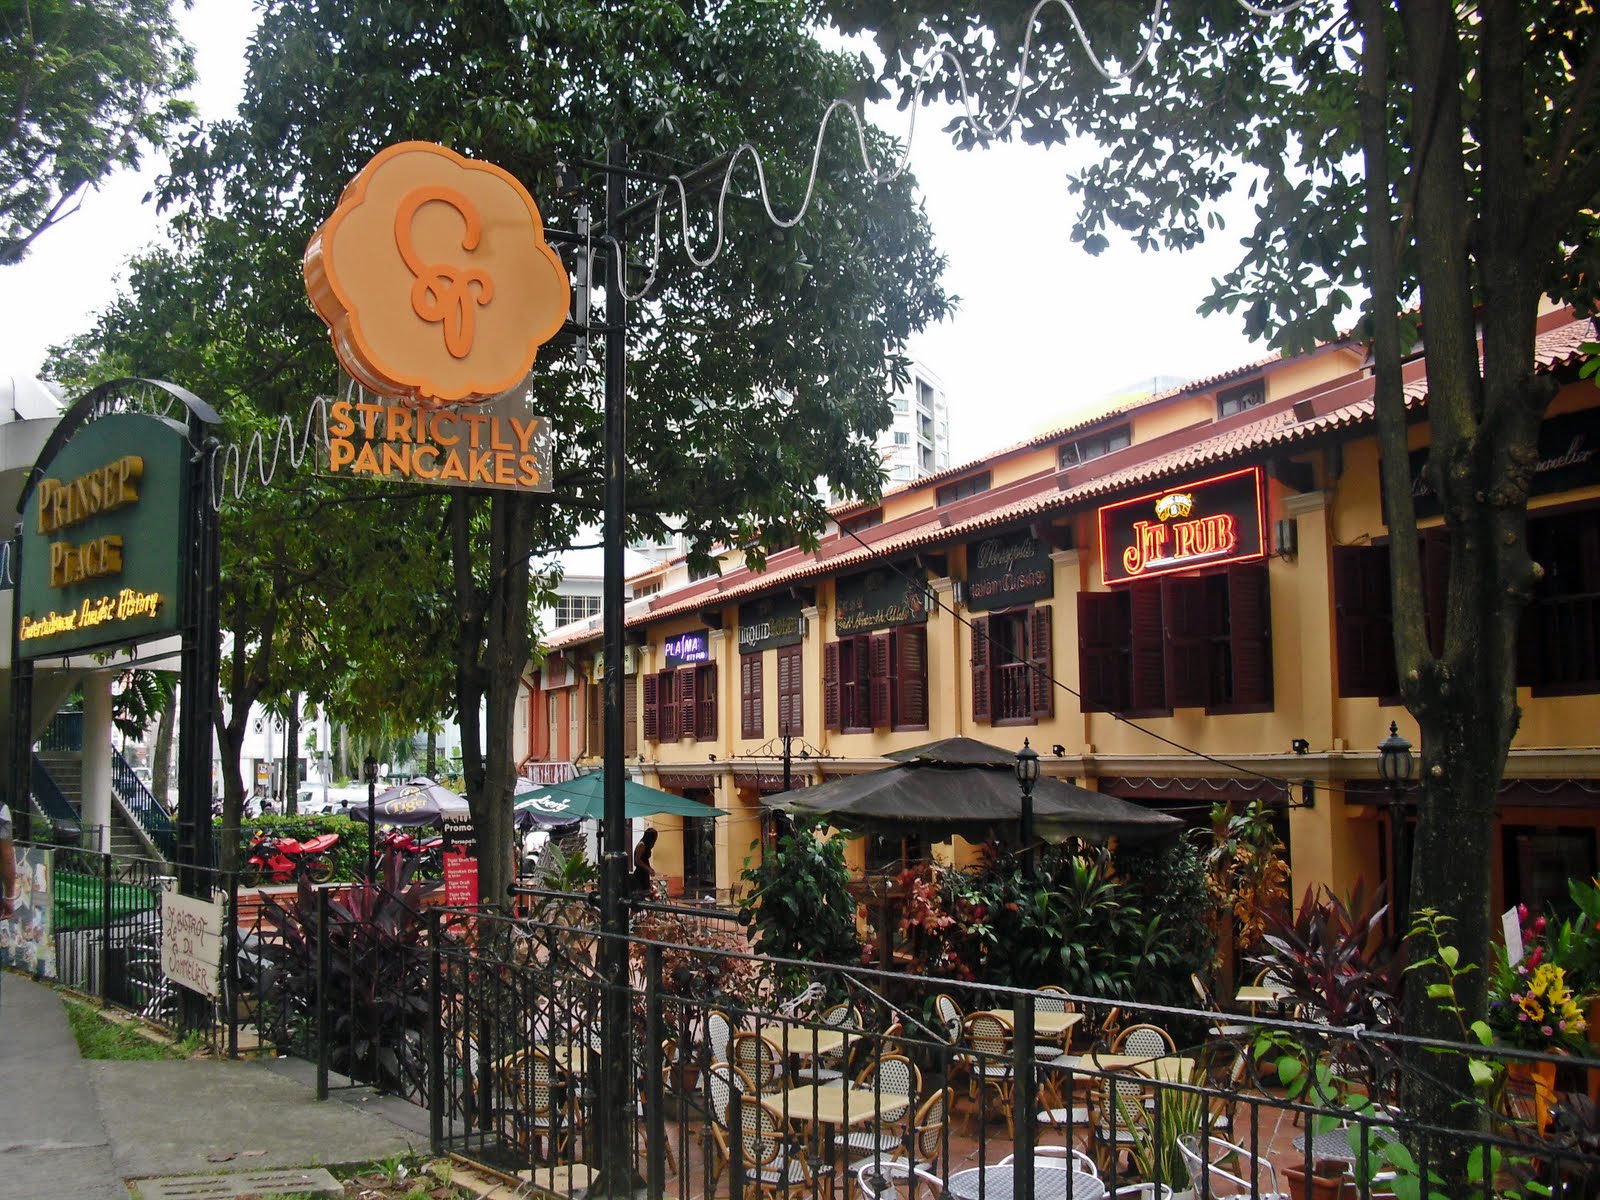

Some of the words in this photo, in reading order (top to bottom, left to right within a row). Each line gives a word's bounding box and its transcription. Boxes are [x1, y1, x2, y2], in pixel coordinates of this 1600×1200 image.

[329, 401, 539, 452] STRICTLY
[330, 439, 540, 487] PANCAKES
[37, 455, 144, 535] PRINSEP
[1173, 514, 1235, 559] PUB
[49, 534, 123, 589] PLACE
[665, 635, 698, 659] PLASMA
[392, 798, 427, 813] Tiger
